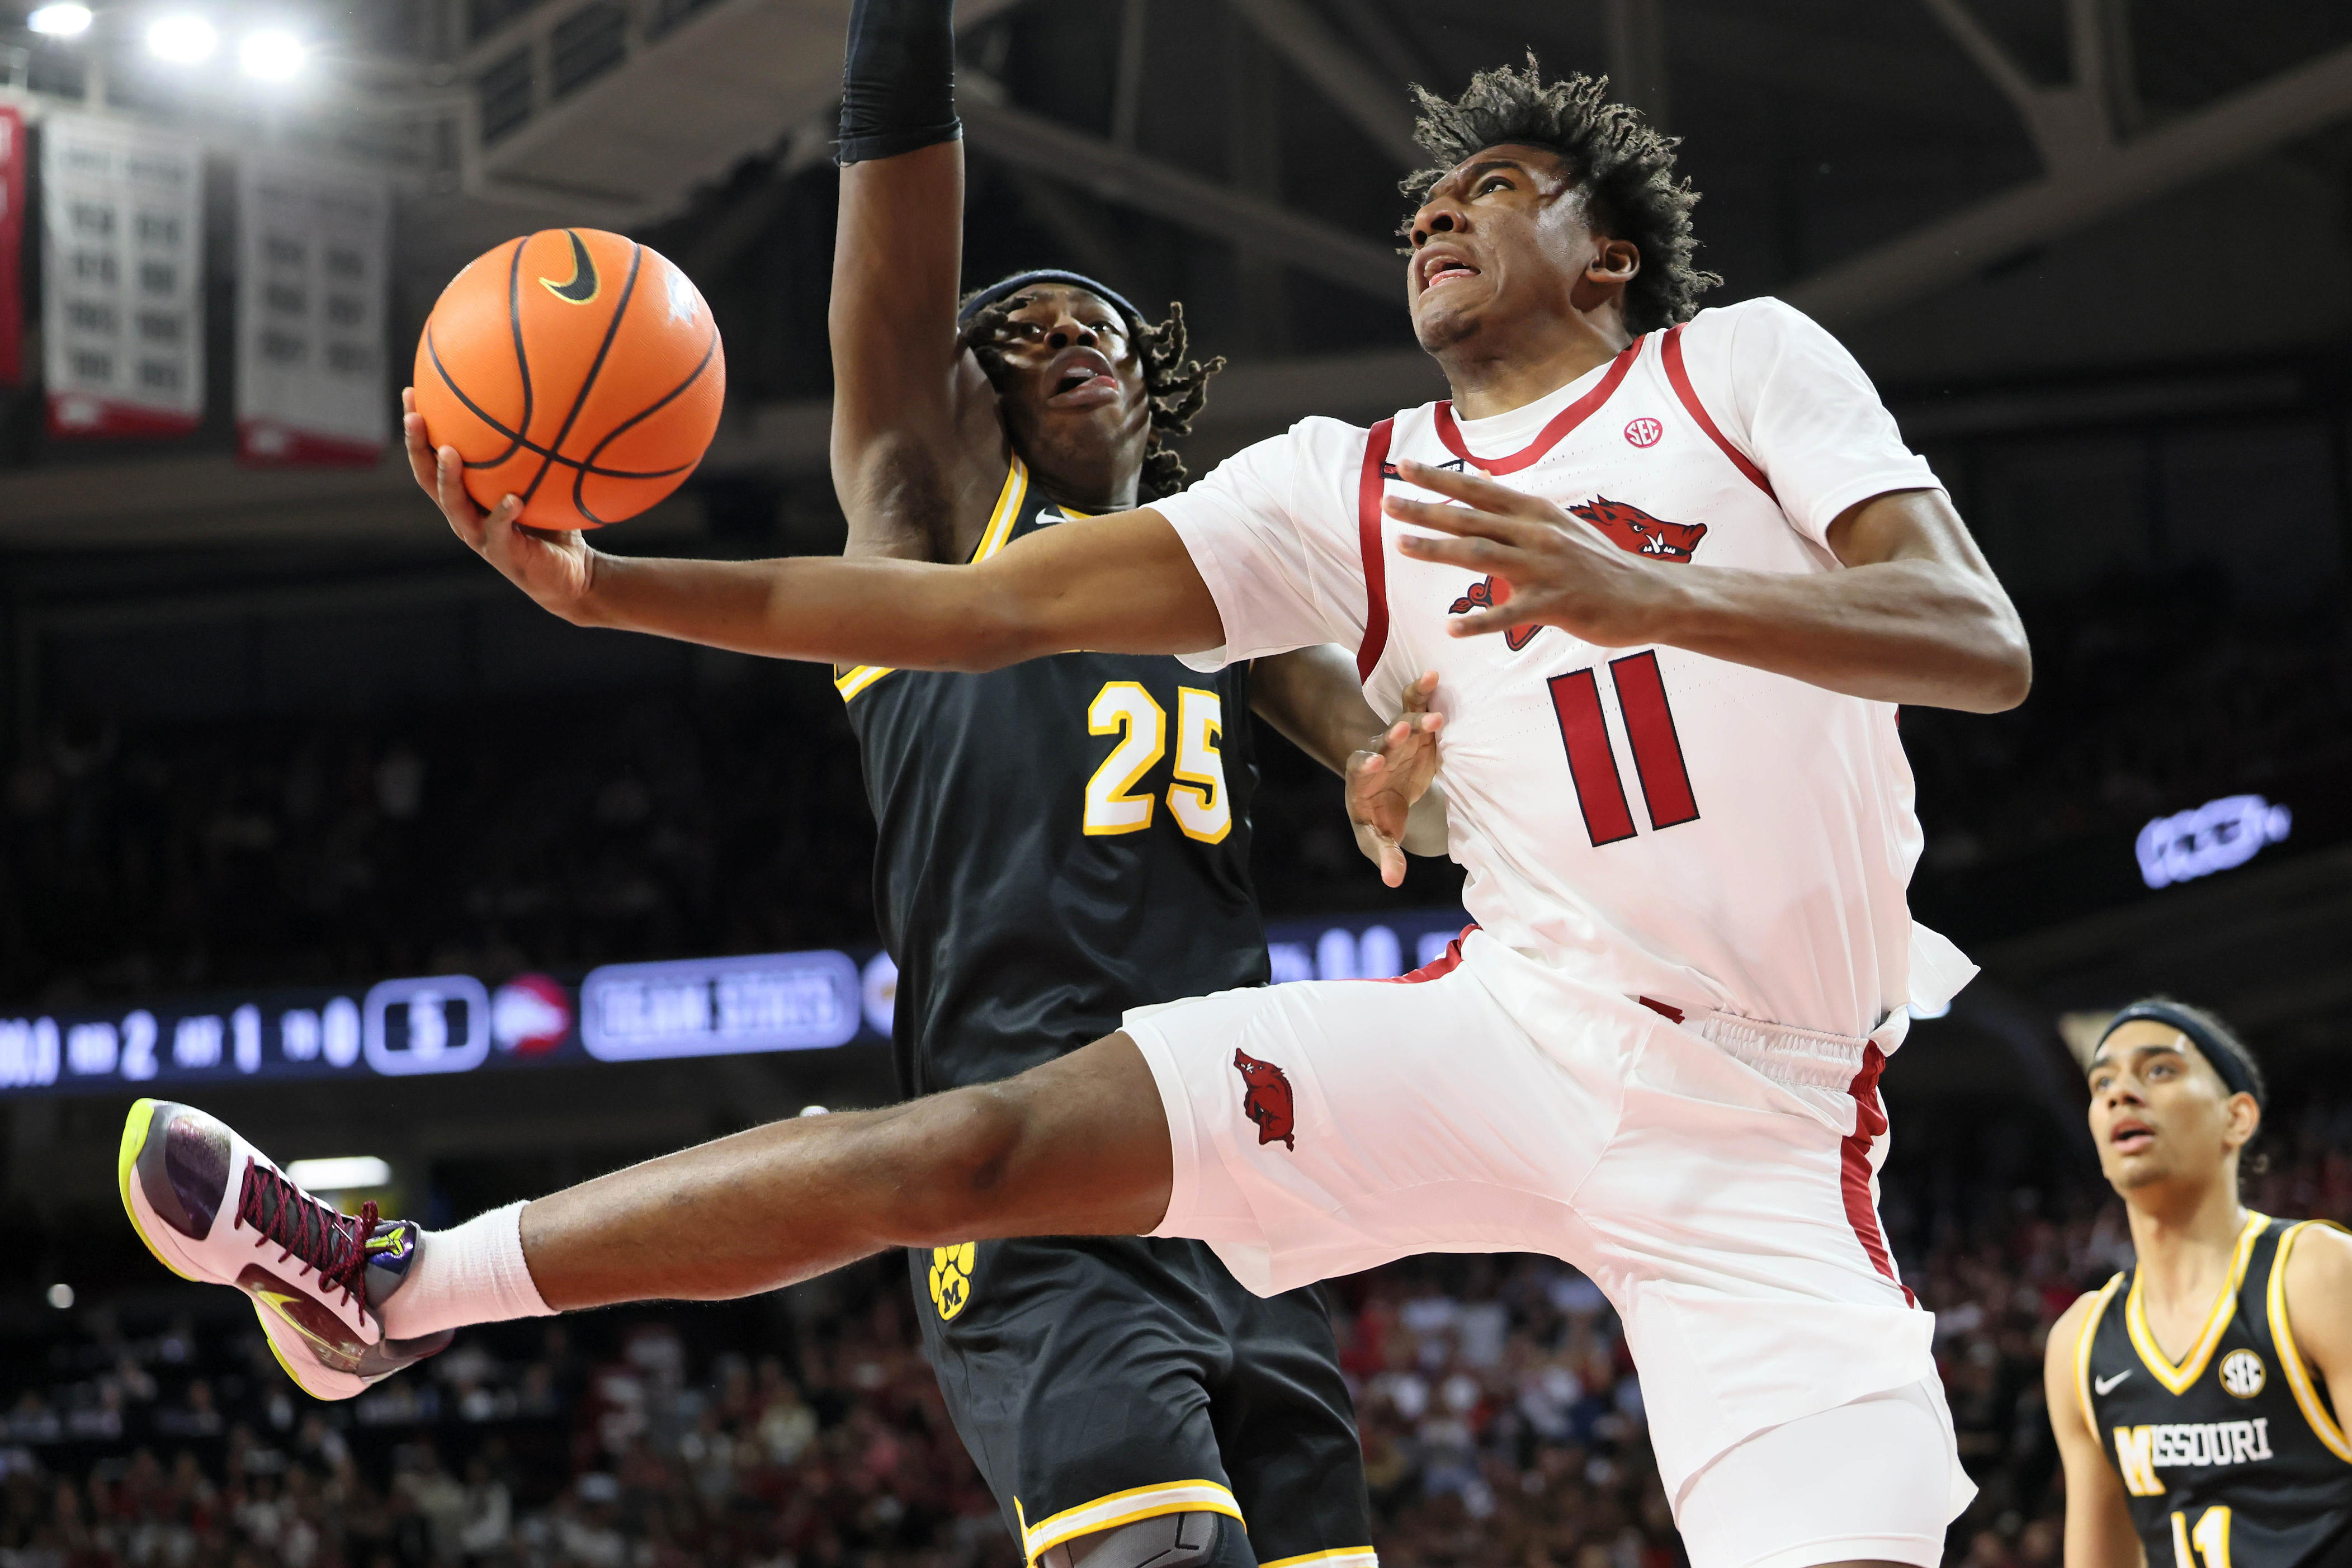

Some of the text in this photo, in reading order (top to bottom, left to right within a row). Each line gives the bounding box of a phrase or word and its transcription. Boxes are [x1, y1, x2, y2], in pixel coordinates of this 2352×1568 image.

[1626, 418, 1660, 446] SEC
[1083, 681, 1232, 845] 25
[1547, 649, 1701, 847] 11
[942, 1279, 962, 1314] M
[2223, 1353, 2261, 1395] SEC
[2114, 1418, 2274, 1496] MISSOURI
